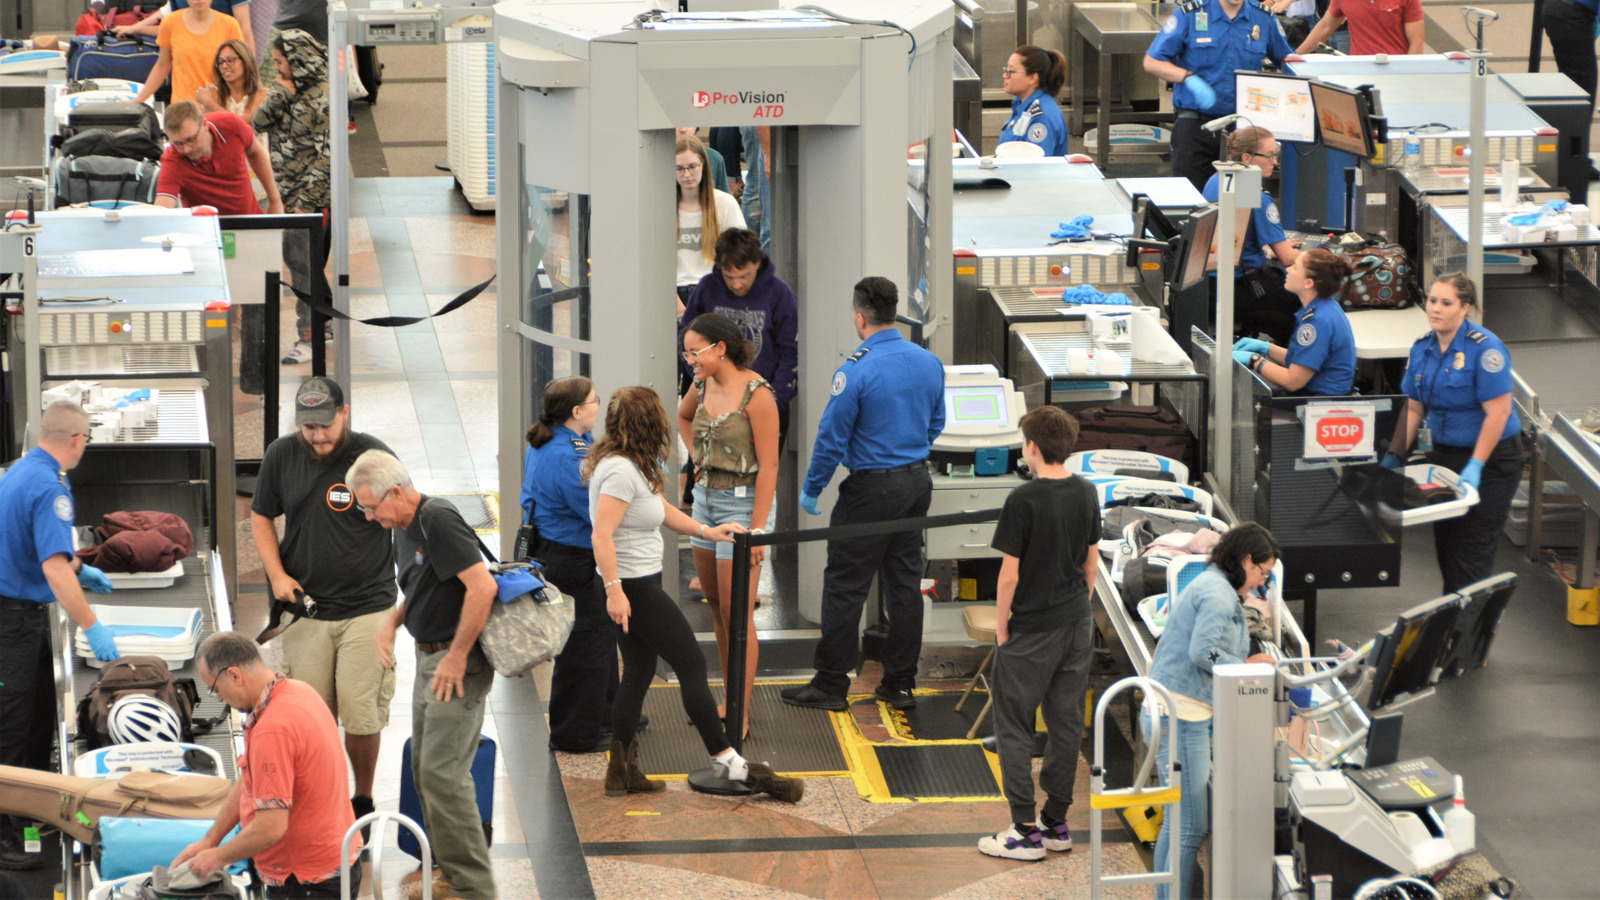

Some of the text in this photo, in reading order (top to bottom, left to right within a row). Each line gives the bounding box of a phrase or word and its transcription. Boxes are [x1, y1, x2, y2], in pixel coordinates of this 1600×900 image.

[1478, 59, 1485, 76] 8
[713, 91, 785, 104] ProVision
[753, 105, 784, 118] ATD
[1225, 173, 1233, 192] 7
[25, 237, 33, 256] 6
[1321, 424, 1360, 437] STOP
[329, 491, 351, 503] IES
[1238, 686, 1269, 695] iLane
